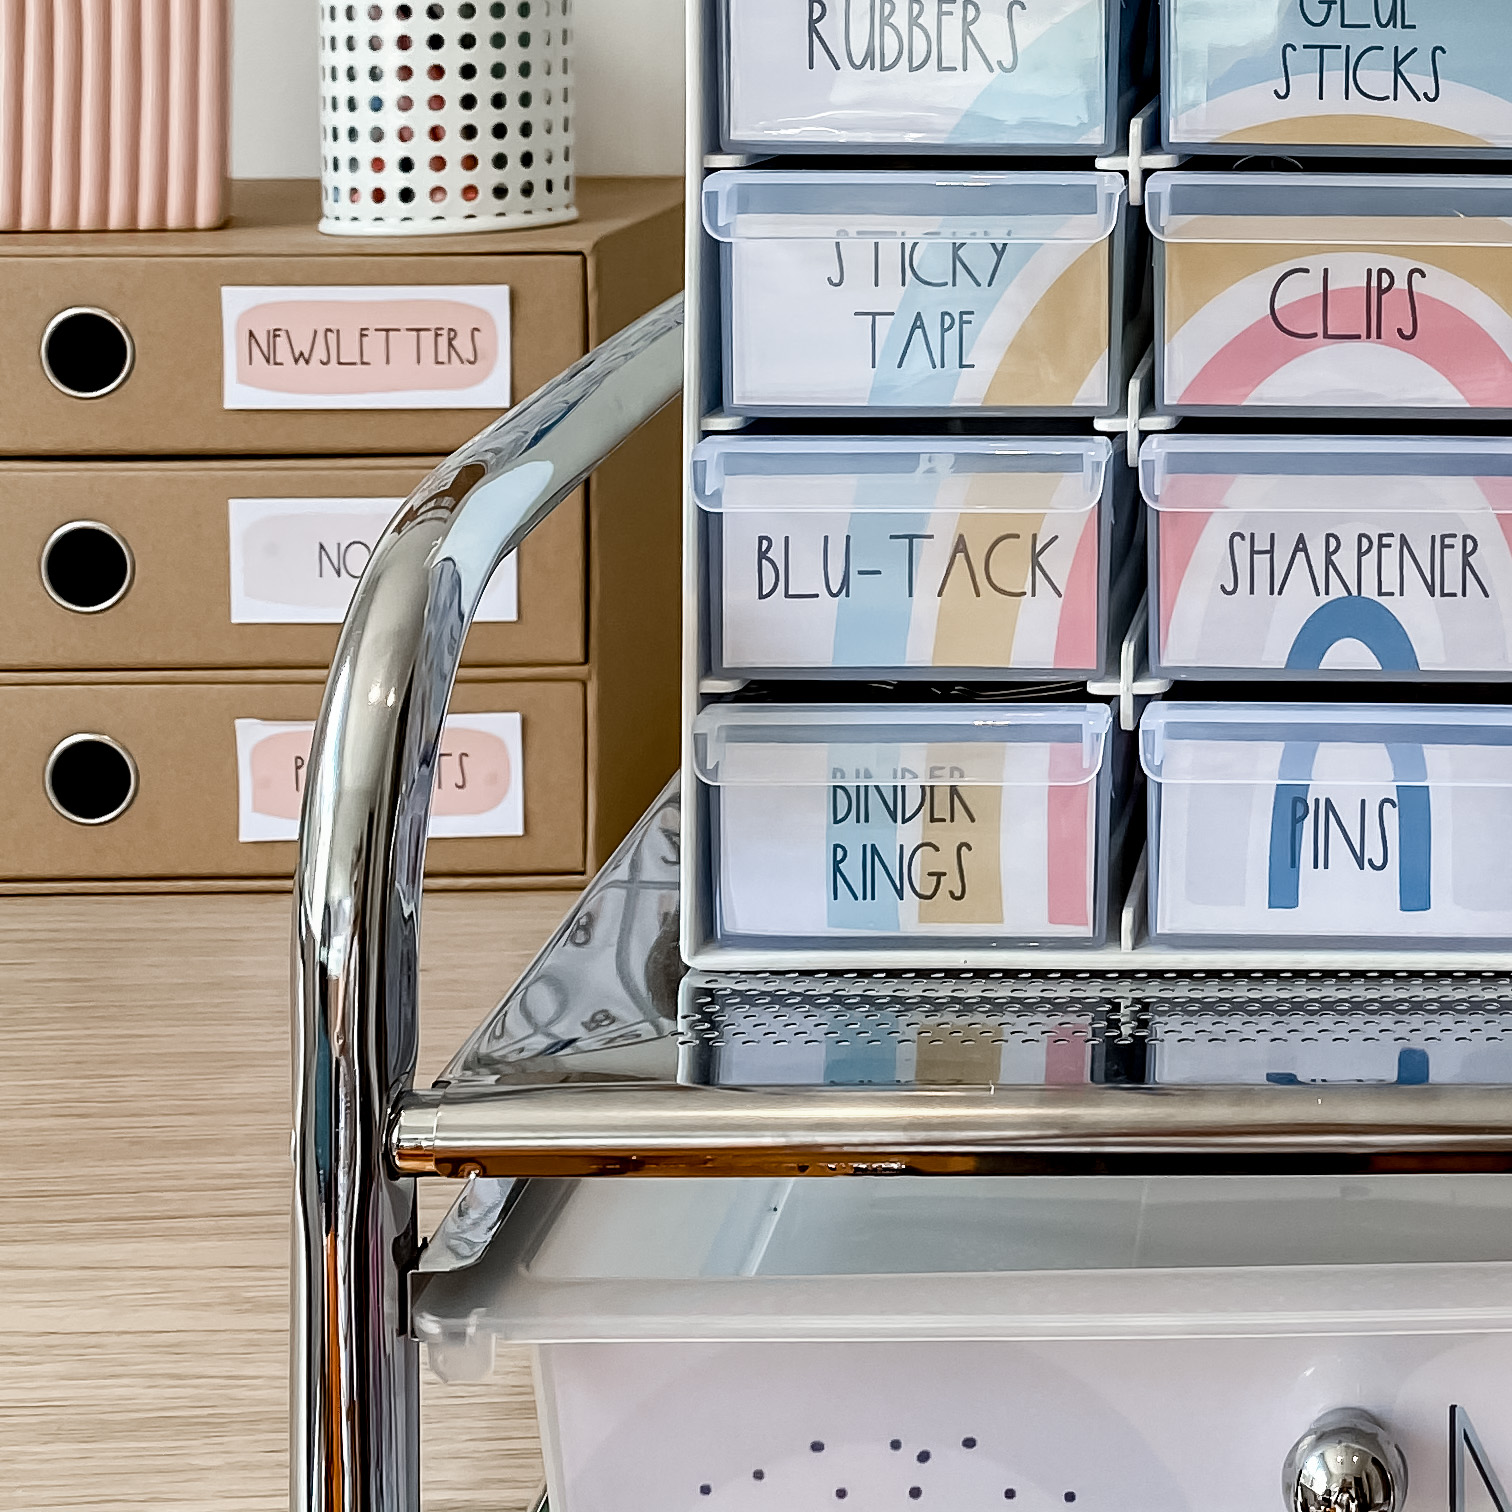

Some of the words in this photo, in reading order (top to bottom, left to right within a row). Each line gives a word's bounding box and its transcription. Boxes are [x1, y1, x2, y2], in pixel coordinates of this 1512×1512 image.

[1273, 43, 1447, 103] STICKS
[826, 228, 1012, 288] STICKY
[1269, 267, 1427, 341] CLIPS
[246, 326, 482, 367] NEWSLETTERS
[854, 310, 976, 370] TAPE
[756, 533, 1063, 601] BLU-TACK
[1220, 530, 1490, 600] SHARPENER
[831, 766, 976, 826] BINDER
[1288, 796, 1398, 872] PINS
[831, 841, 974, 902] RINGS
